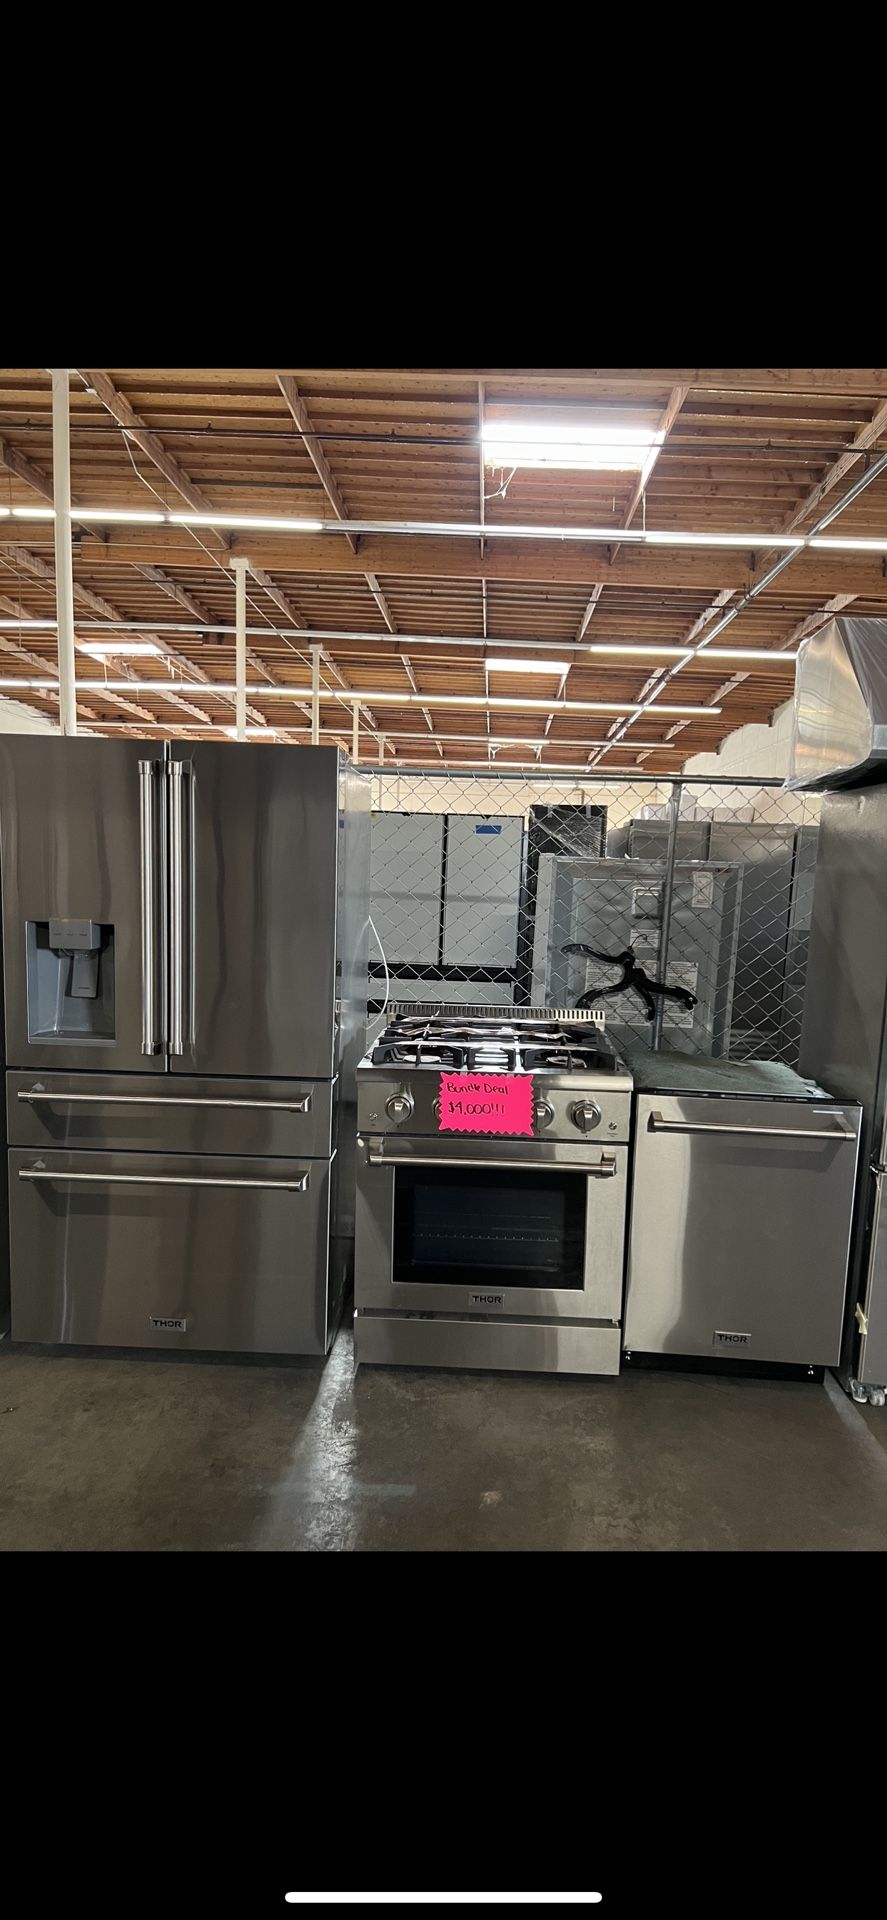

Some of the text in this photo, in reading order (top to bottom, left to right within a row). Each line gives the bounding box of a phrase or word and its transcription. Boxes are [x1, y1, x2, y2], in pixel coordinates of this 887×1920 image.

[447, 1082, 509, 1095] Bundle Deal
[472, 1295, 502, 1304] THOR
[152, 1319, 182, 1328] THOR
[717, 1334, 749, 1344] THOR
